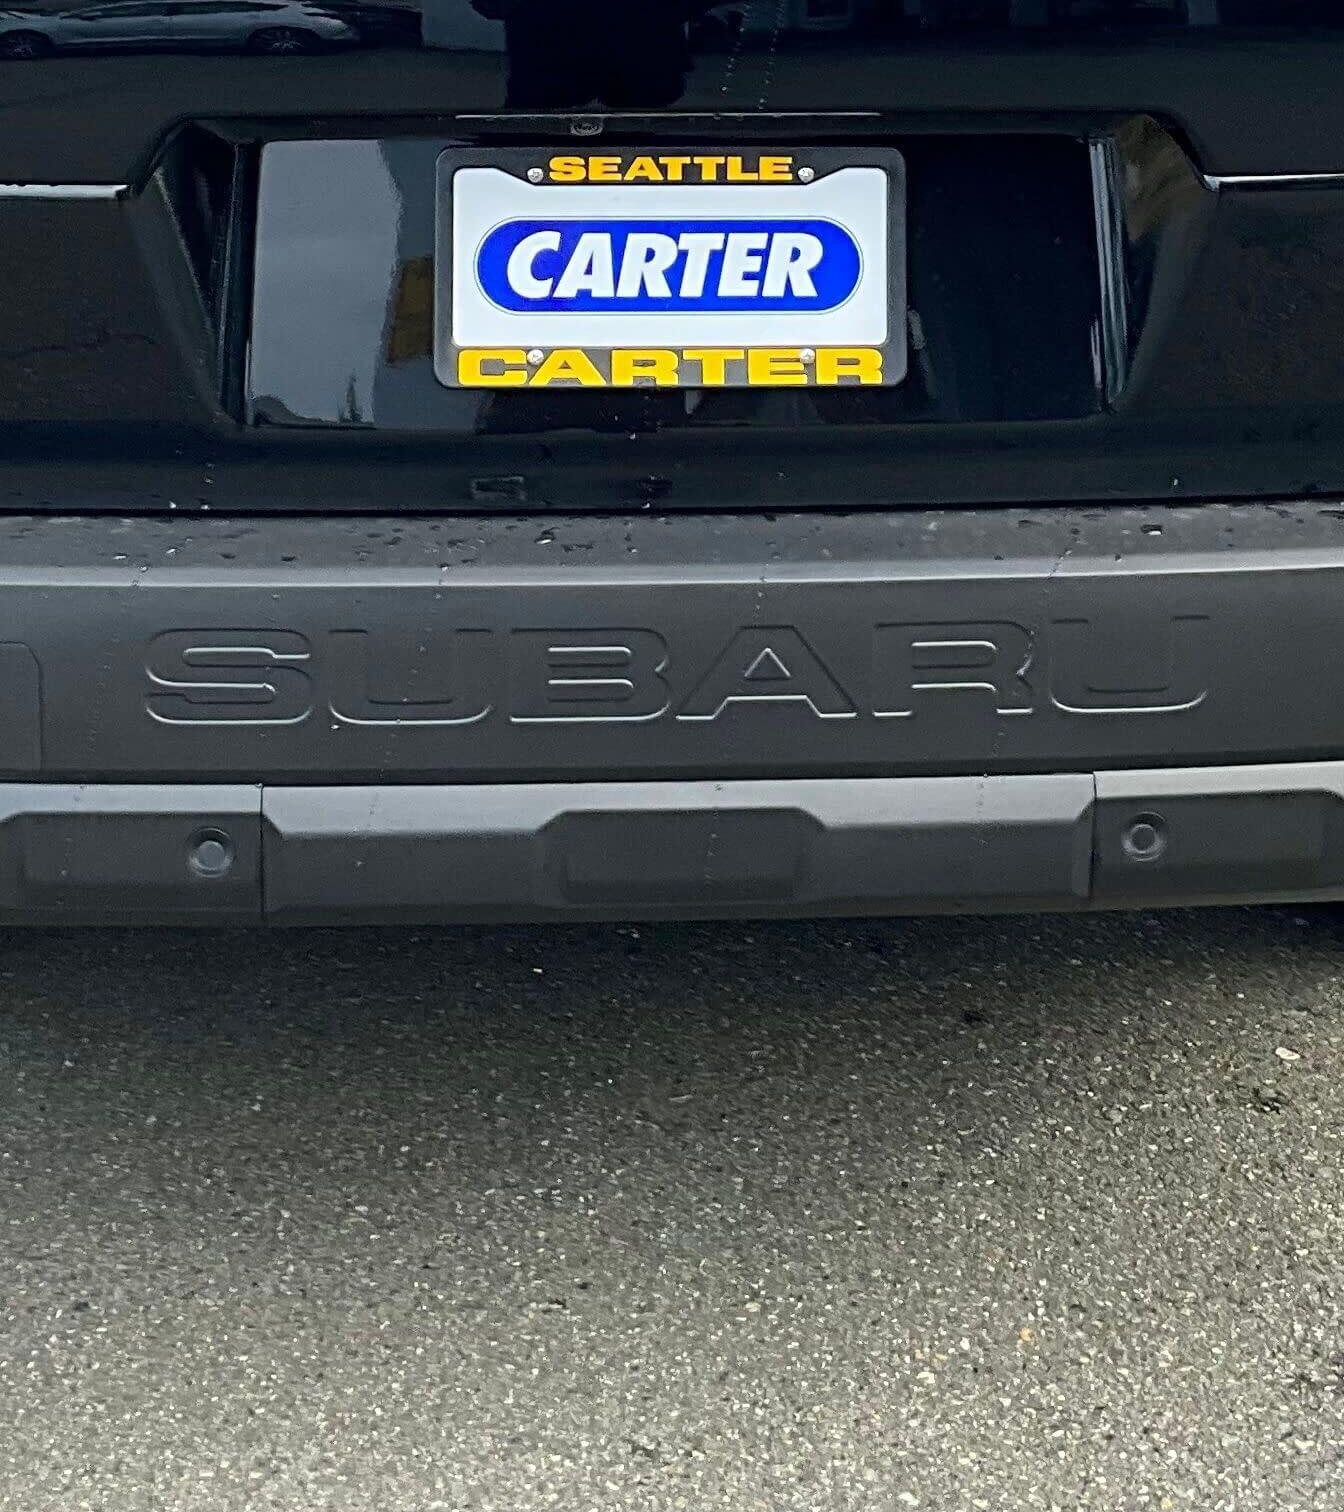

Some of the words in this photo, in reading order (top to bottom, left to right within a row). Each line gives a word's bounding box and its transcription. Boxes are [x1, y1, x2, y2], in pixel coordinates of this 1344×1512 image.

[548, 156, 794, 182] SEATTLE
[506, 231, 824, 299] CARTER
[457, 348, 884, 386] CARTER
[144, 615, 1209, 724] SUBARU
